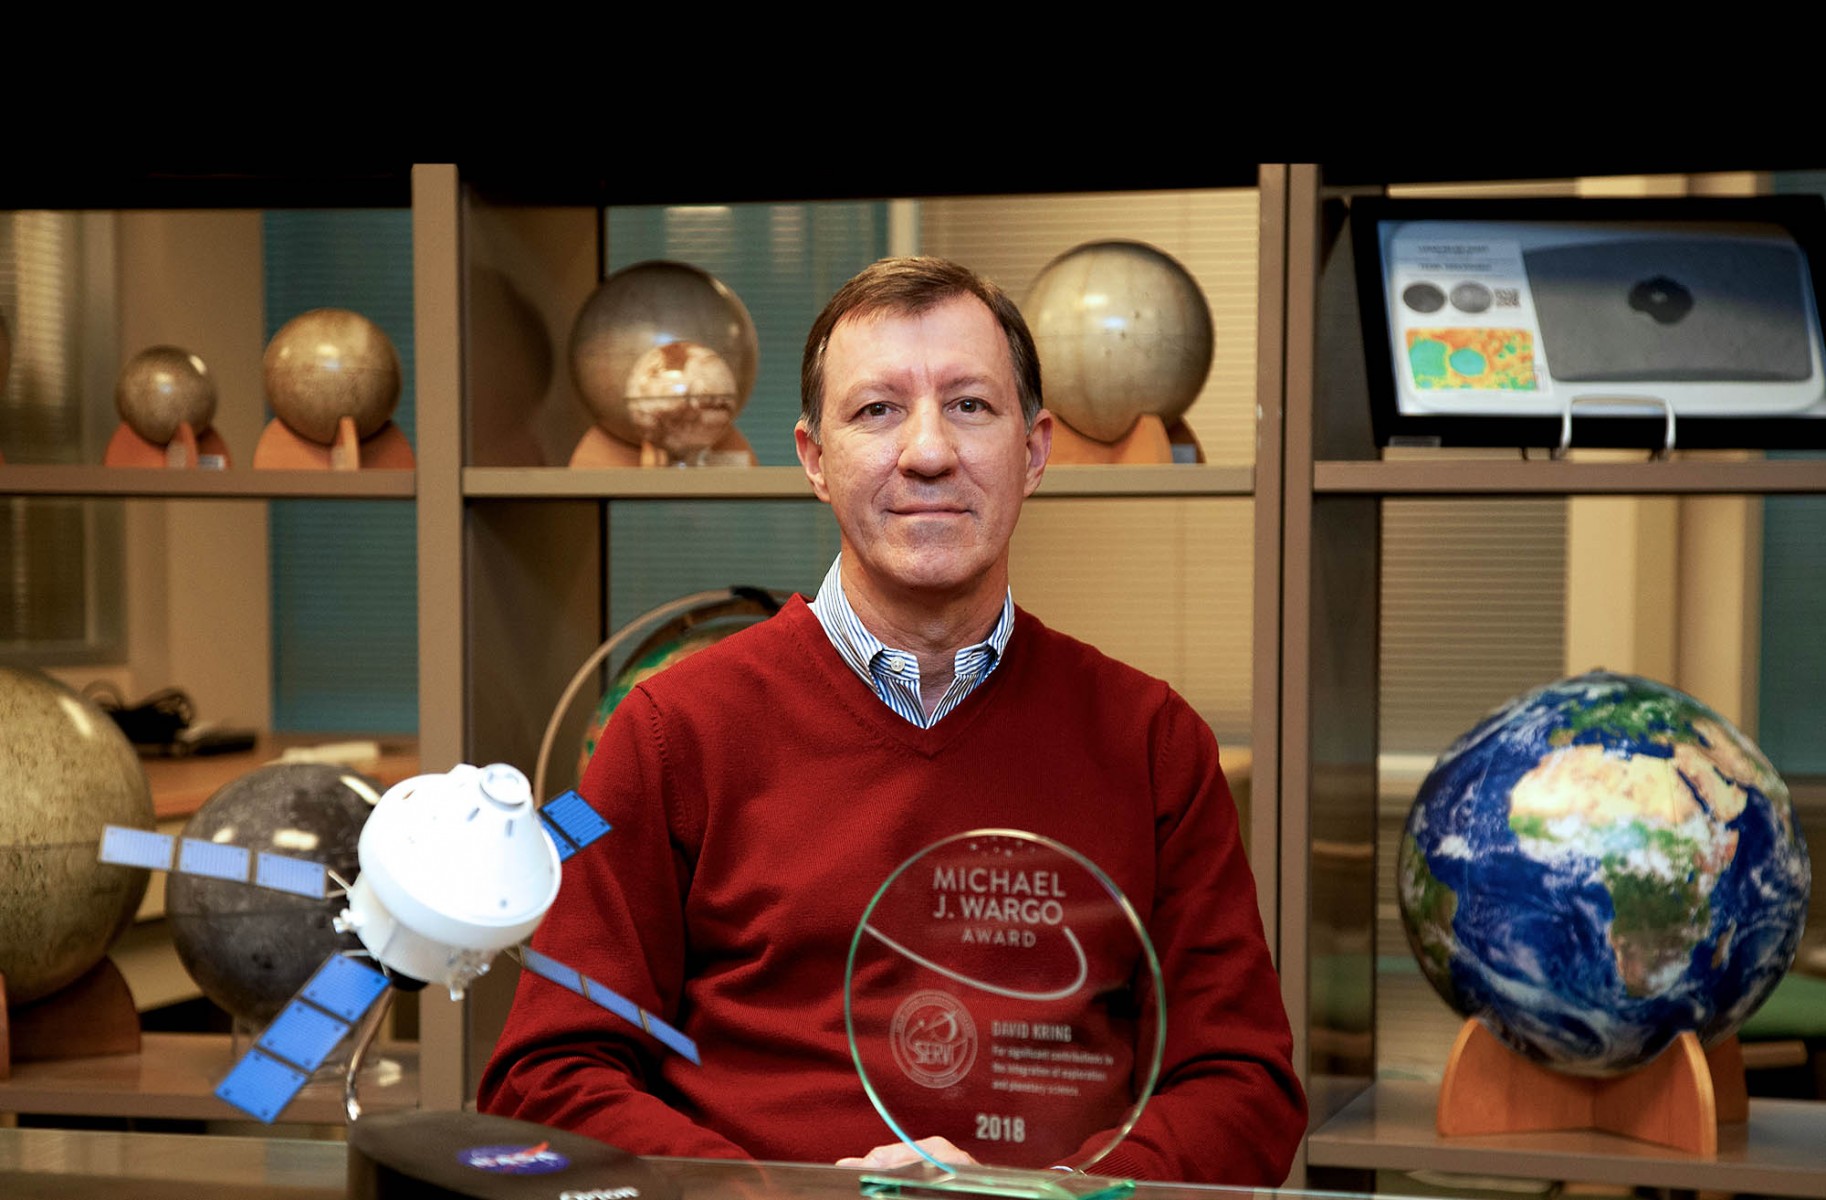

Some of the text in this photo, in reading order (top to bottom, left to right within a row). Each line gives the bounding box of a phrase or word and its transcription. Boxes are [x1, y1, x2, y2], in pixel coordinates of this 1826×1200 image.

[933, 866, 1067, 897] MICHAEL
[933, 893, 1063, 925] J. WARGO
[962, 927, 1036, 948] AWARD
[992, 1021, 1072, 1042] DAVID KRING
[1008, 1047, 1049, 1060] significant
[1051, 1050, 1103, 1064] contributions
[1008, 1064, 1050, 1077] integration
[1062, 1069, 1107, 1081] exploration
[992, 1079, 1008, 1090] and
[1009, 1081, 1046, 1095] planetary
[976, 1114, 1025, 1143] 2018
